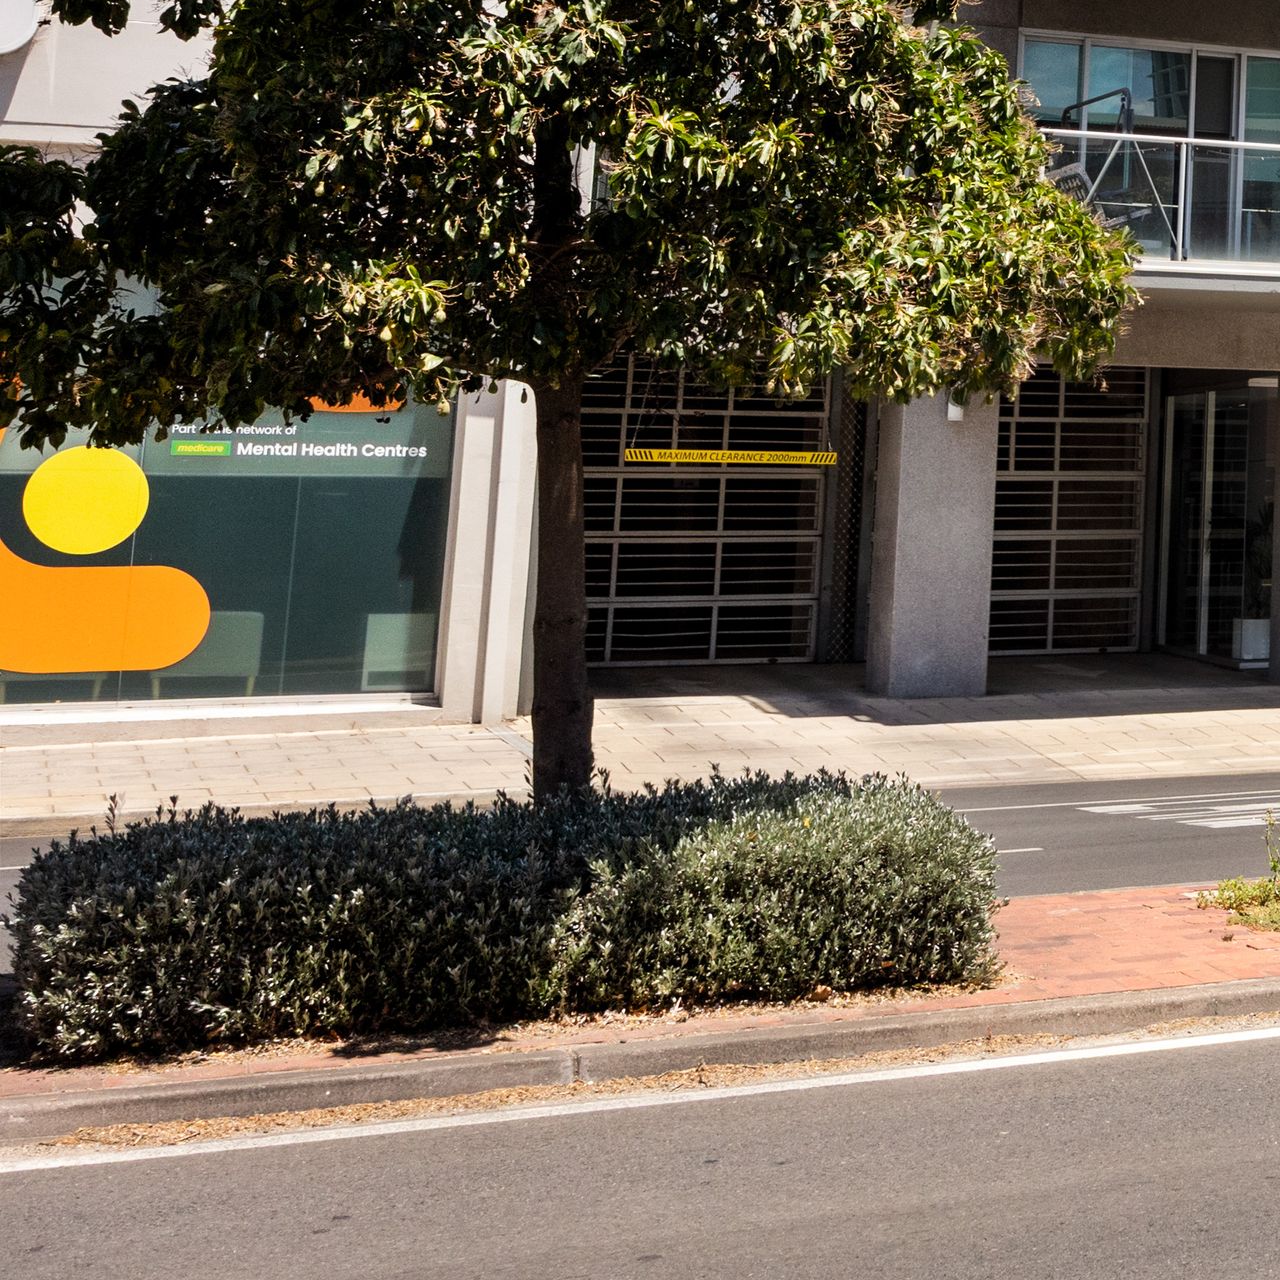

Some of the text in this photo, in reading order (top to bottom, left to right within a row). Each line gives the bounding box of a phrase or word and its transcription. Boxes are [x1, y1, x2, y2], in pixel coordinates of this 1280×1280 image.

[171, 424, 196, 434] Part
[236, 425, 282, 435] network
[285, 425, 298, 435] of
[176, 442, 428, 457] medicare Mental Health Centres
[657, 451, 807, 462] MAXIMUM CLEARANCE 2000mm
